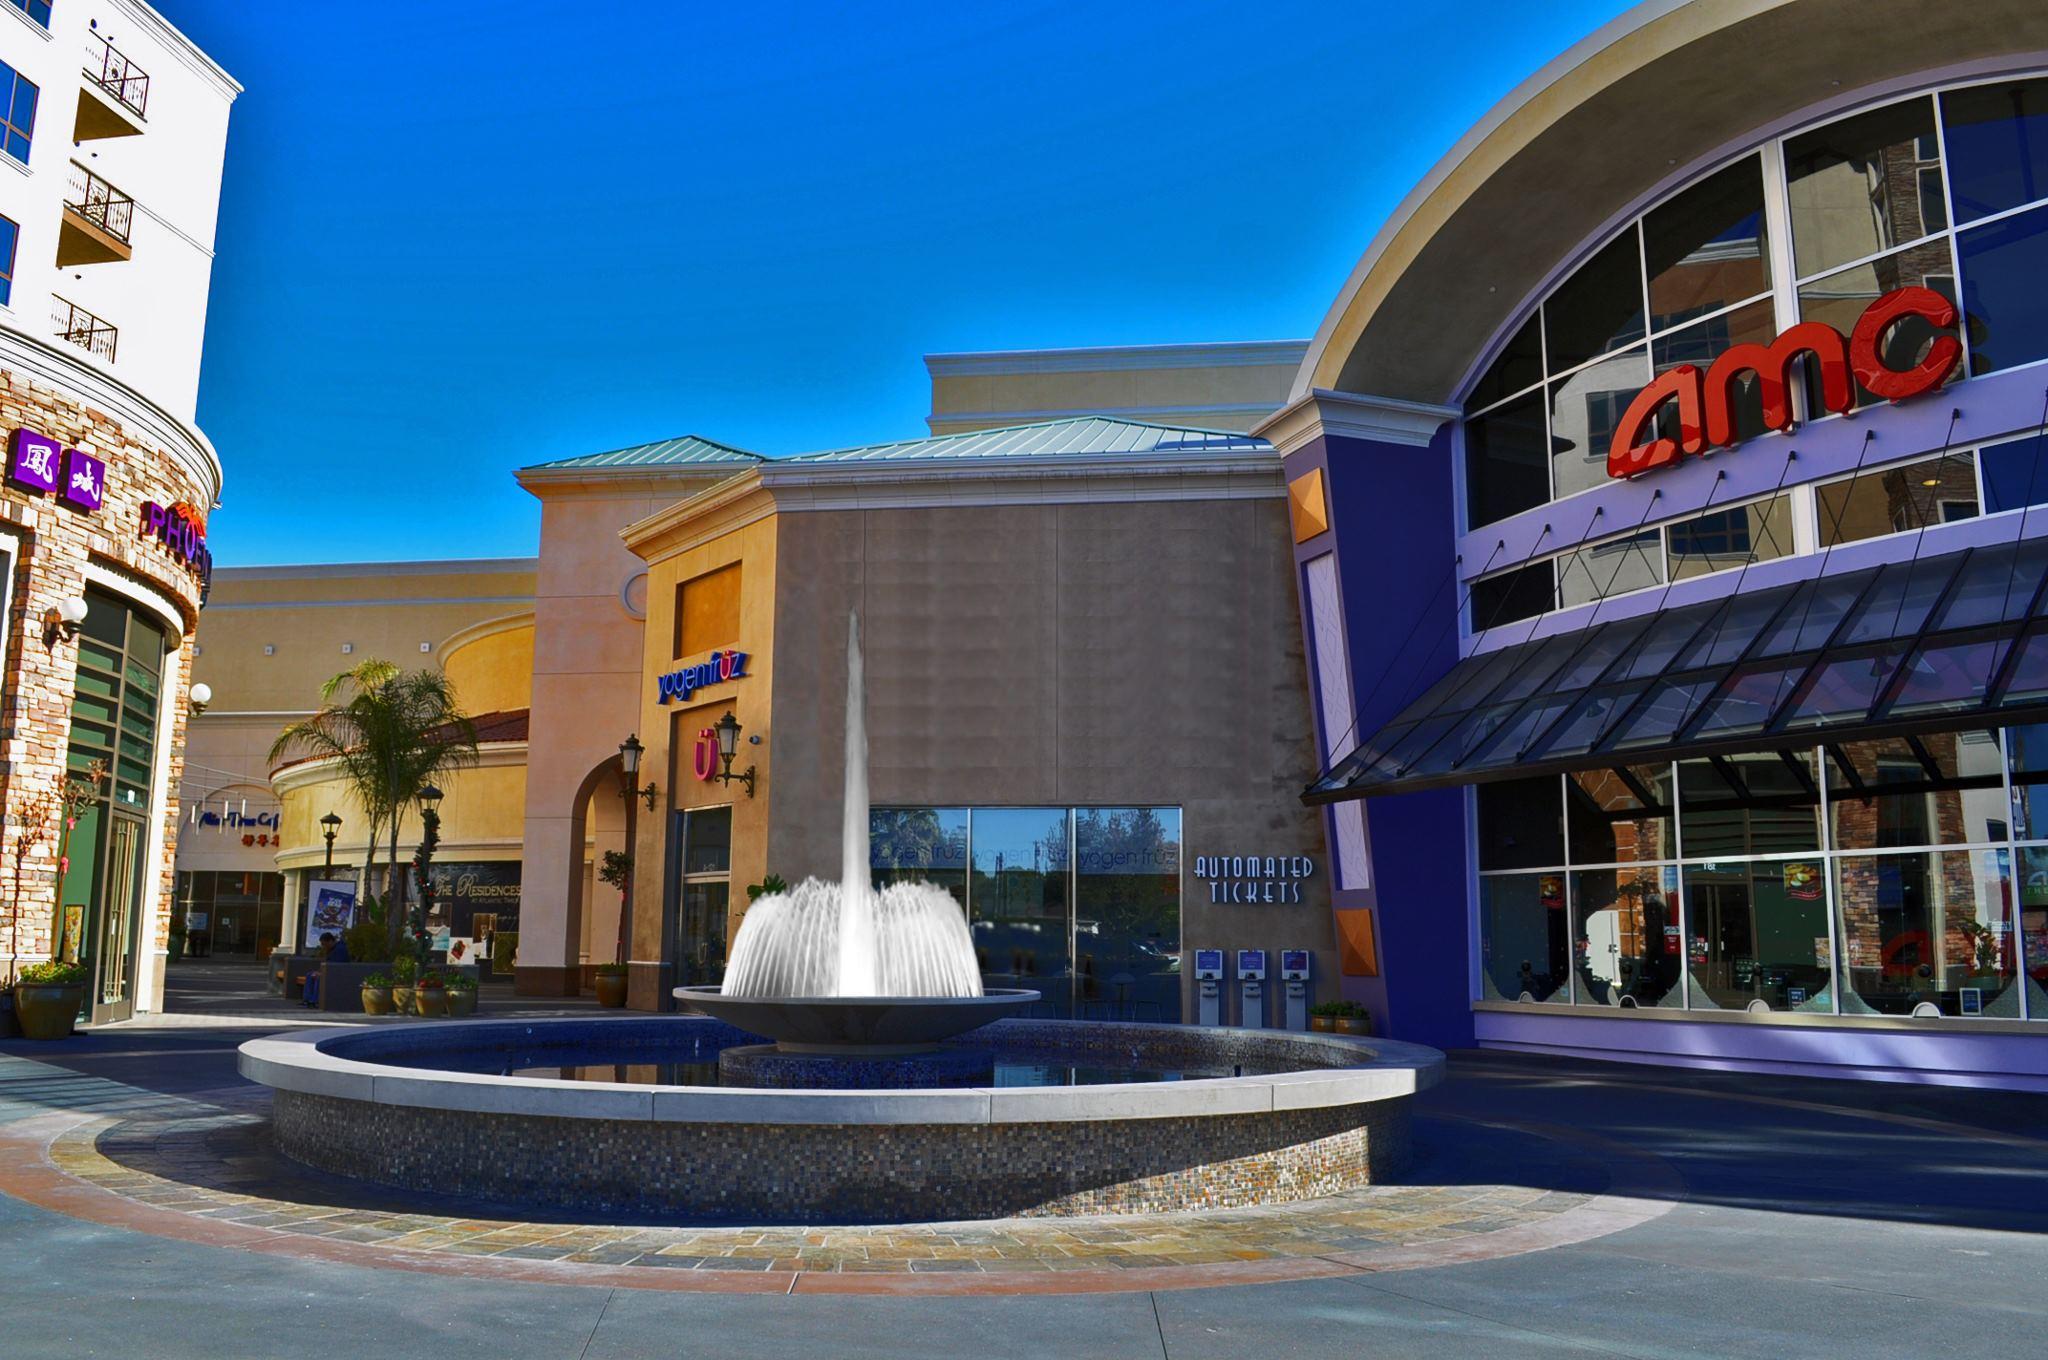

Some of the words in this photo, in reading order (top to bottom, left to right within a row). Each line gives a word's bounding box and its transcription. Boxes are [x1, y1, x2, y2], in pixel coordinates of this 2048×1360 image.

[1607, 286, 1963, 479] amc
[656, 664, 708, 705] yogen
[257, 812, 280, 832] Caf
[1080, 850, 1138, 870] yogen
[1194, 856, 1313, 878] AUTOMATED
[456, 873, 522, 897] RESIDENCES
[1209, 881, 1299, 903] TICKETS
